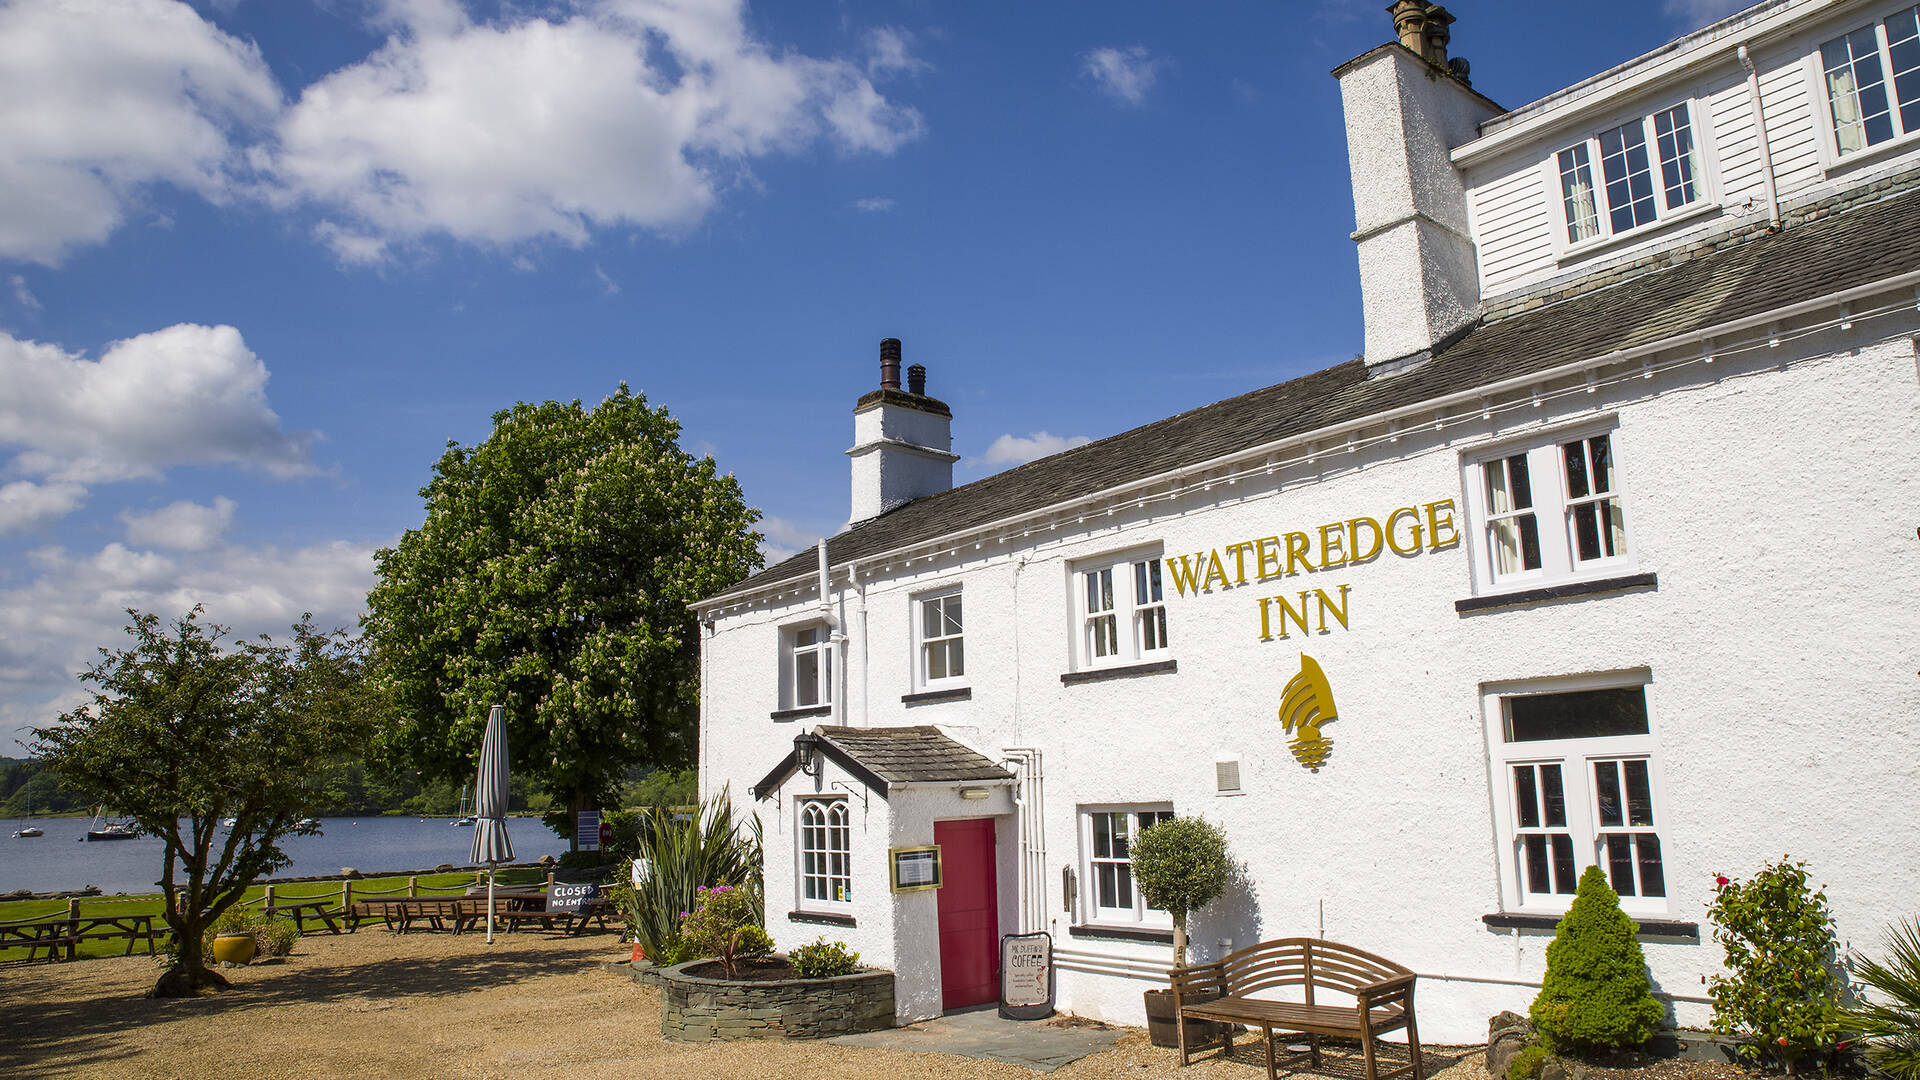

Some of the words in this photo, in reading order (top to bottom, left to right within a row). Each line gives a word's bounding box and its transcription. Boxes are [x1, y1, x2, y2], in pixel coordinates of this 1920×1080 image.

[1165, 498, 1458, 595] WATEREDGE
[1256, 584, 1350, 639] INN
[554, 886, 594, 897] CLOSED
[552, 899, 564, 907] NO
[1011, 954, 1043, 967] COFFEE
